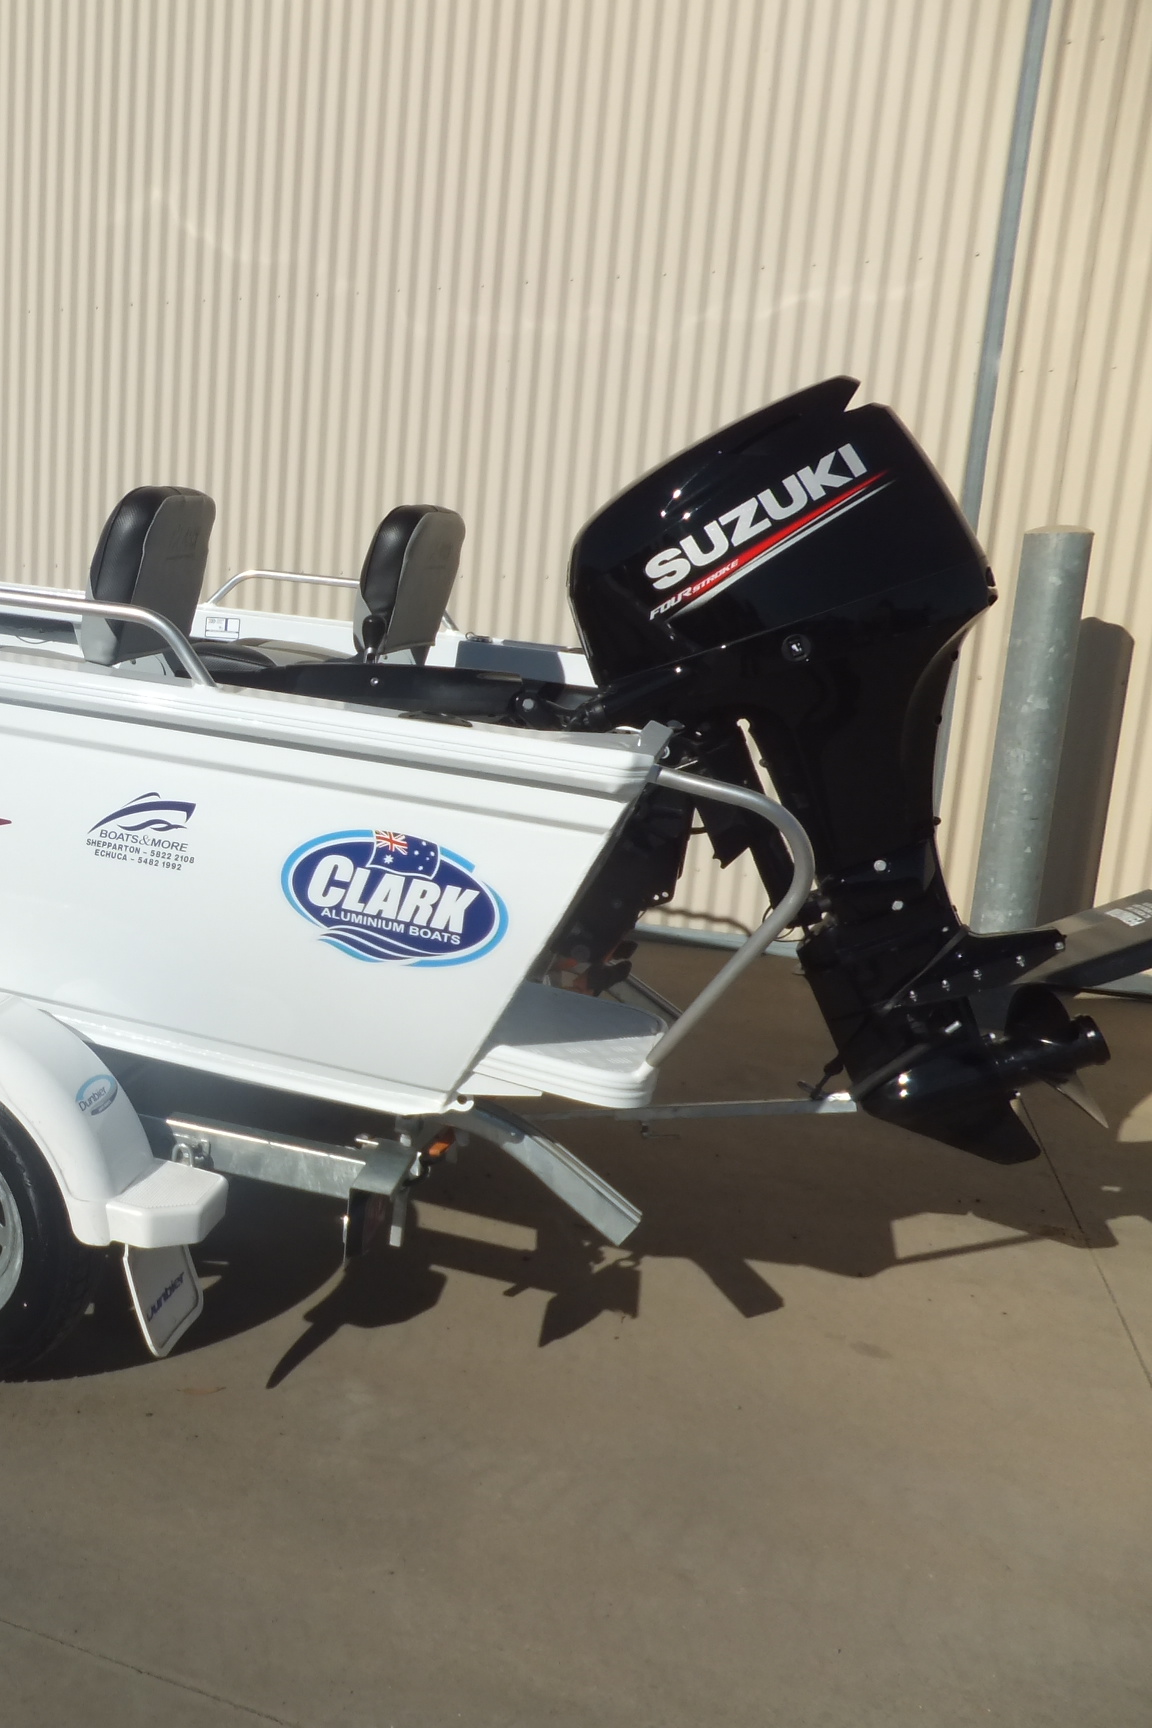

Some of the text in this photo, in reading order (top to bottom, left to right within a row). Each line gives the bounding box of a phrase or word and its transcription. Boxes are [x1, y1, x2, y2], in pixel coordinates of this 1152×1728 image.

[645, 443, 867, 590] SUZUKI
[86, 838, 141, 855] SHEPPARTON
[150, 849, 172, 860] 5822
[174, 853, 195, 864] 2108
[94, 848, 128, 861] ECHUCA
[138, 856, 159, 867] 5482
[162, 861, 182, 871] 1992
[307, 854, 480, 934] CLARK
[320, 907, 461, 945] ALUMINIUM BOATS
[78, 1086, 107, 1112] Dunbier
